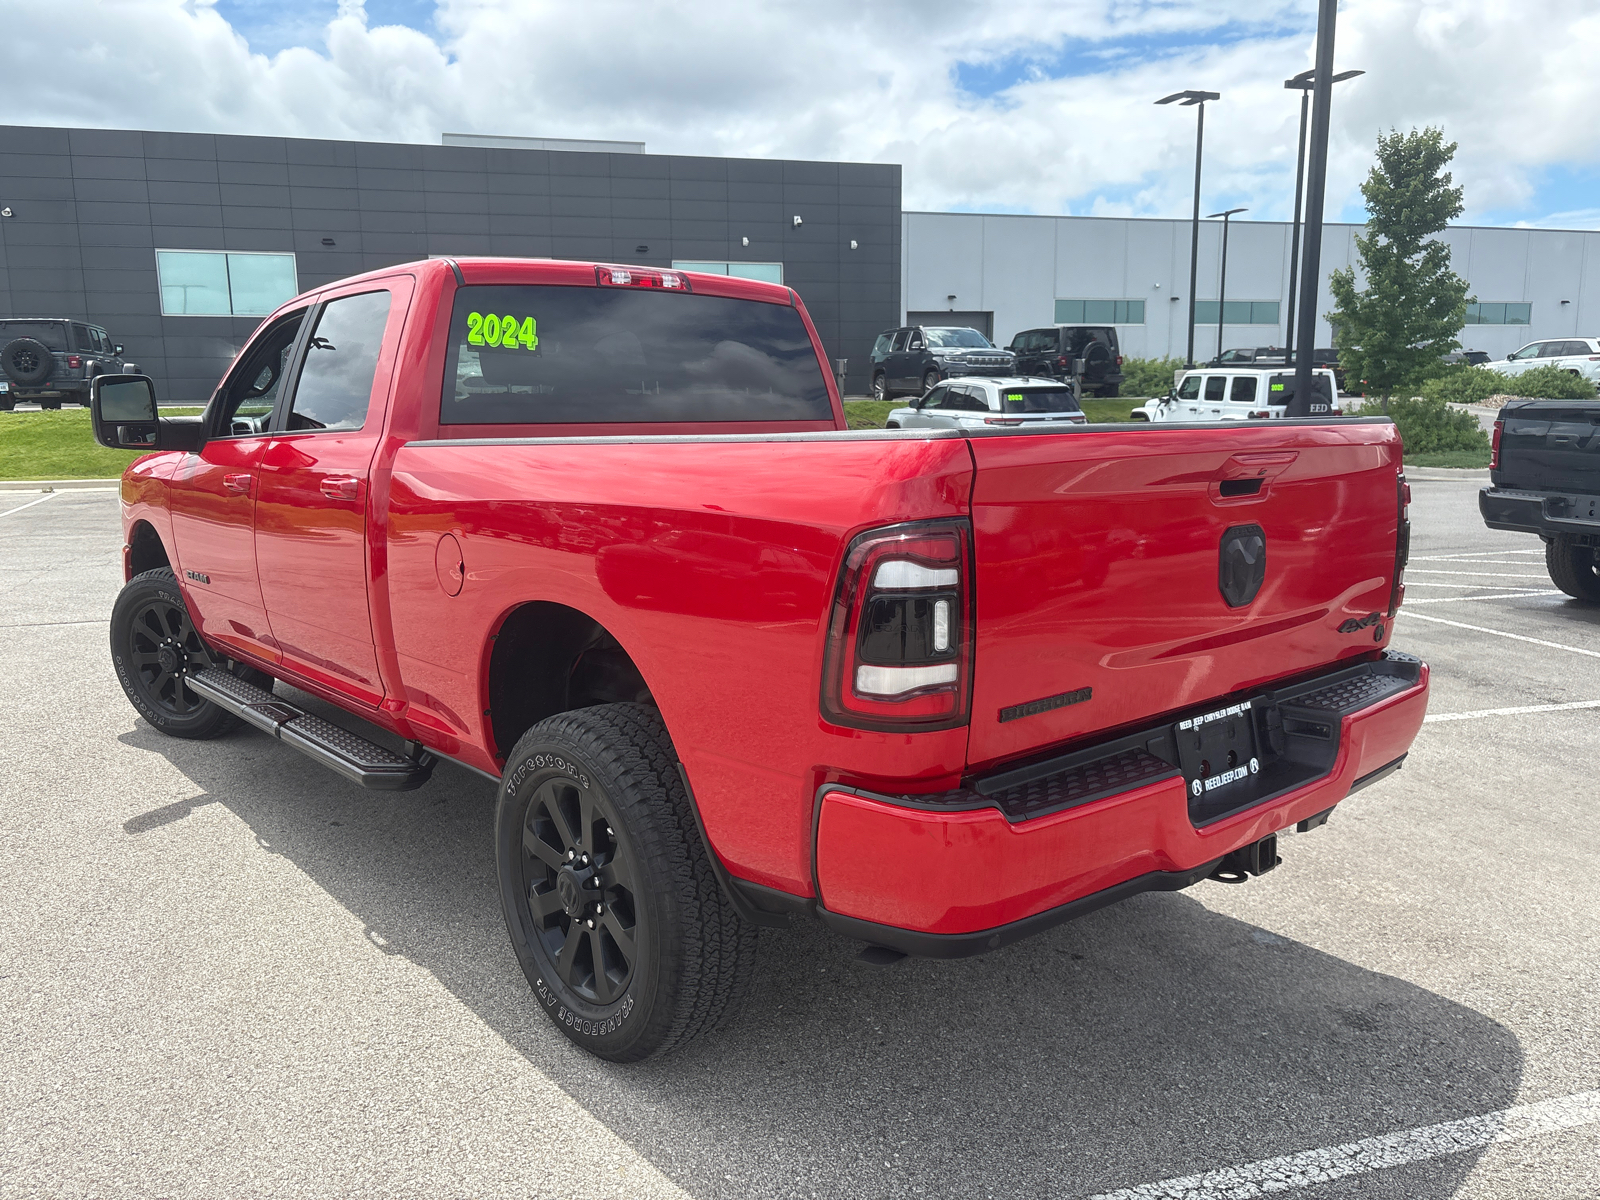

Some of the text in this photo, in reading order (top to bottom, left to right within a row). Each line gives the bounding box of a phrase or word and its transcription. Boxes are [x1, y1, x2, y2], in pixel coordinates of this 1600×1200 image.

[467, 311, 539, 351] 2024
[1310, 403, 1328, 413] EED
[186, 569, 209, 585] RAM
[999, 686, 1093, 723] BIGHORN
[1180, 701, 1252, 730] REED JEEP CHRYSLER DODGE RAM
[1204, 766, 1248, 791] REEDJEEP.COM
[557, 993, 635, 1036] TRANSFORCE
